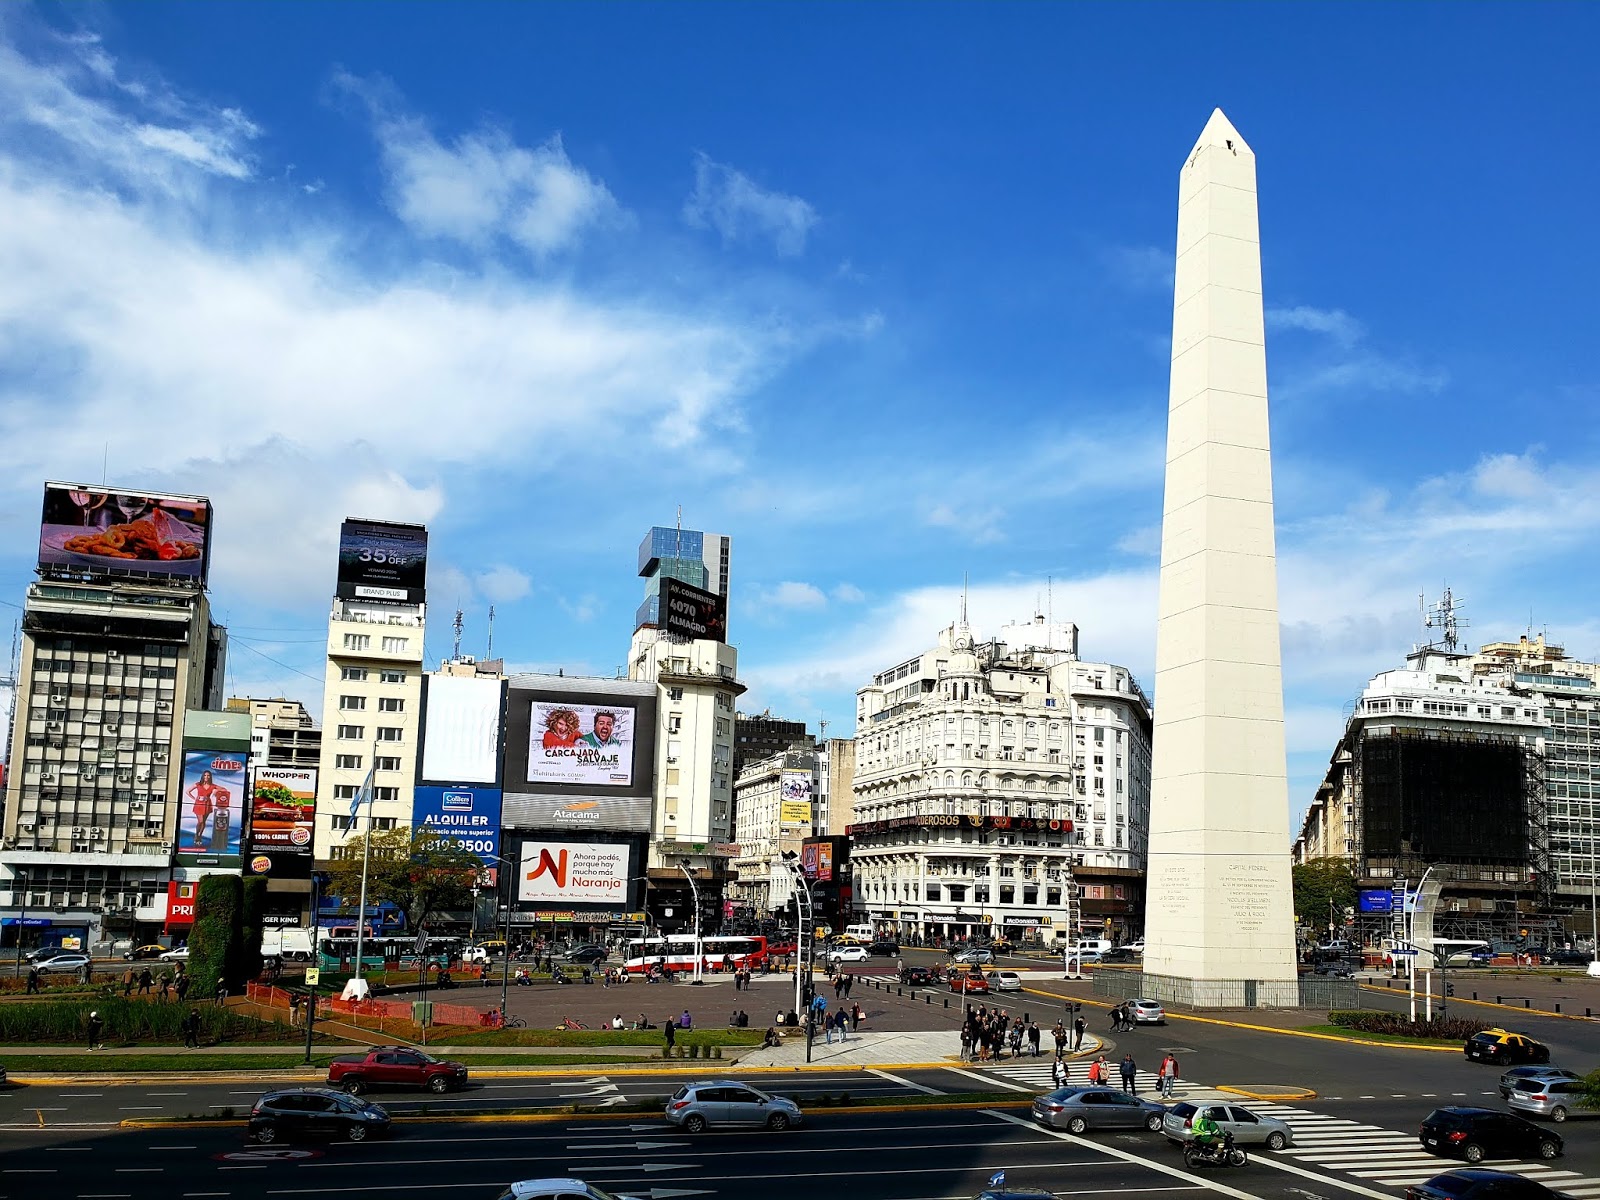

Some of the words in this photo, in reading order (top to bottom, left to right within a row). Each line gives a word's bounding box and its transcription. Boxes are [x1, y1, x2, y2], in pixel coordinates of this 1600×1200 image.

[359, 547, 387, 563] 35
[388, 557, 407, 565] OFF
[681, 588, 716, 606] CORRIENTES
[670, 599, 696, 617] 4070
[669, 615, 707, 633] ALMAGRO
[545, 748, 600, 758] CARCAJADA
[576, 754, 619, 763] SALVAJE
[552, 809, 600, 819] Atacama
[424, 814, 488, 826] ALQUILER
[915, 814, 960, 826] PODEROSOS
[469, 829, 494, 837] superior
[573, 852, 596, 860] Ahora
[597, 853, 621, 862] podés,
[572, 860, 600, 869] porque
[600, 860, 615, 869] hay
[572, 868, 598, 876] mucho
[572, 876, 621, 891] Naranja
